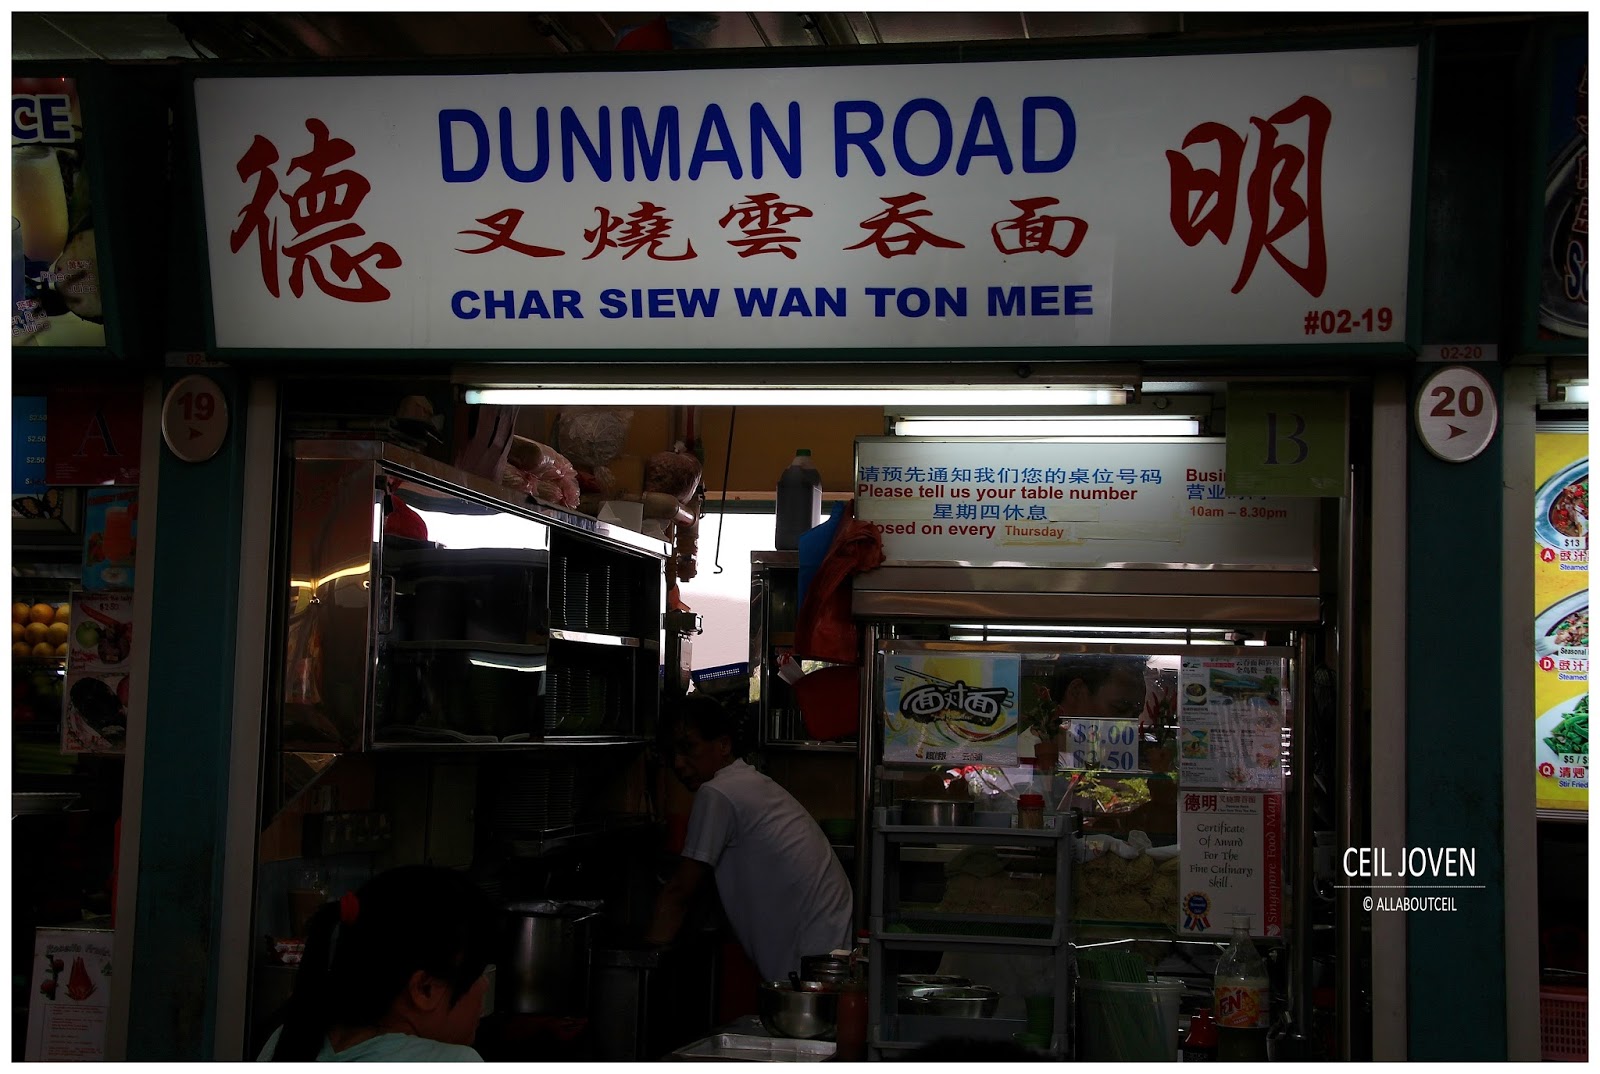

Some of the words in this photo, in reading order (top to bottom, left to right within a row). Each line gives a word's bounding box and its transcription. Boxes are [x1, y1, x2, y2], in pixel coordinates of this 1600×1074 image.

[438, 100, 803, 184] DUNMAN
[834, 95, 1077, 178] ROAD
[1165, 95, 1332, 298] 明
[230, 118, 402, 303] 德
[450, 289, 584, 321] CHAR
[599, 288, 720, 319] SIEW
[734, 287, 848, 319] WAN
[865, 286, 968, 318] TON
[986, 284, 1094, 317] MEE
[1304, 308, 1393, 335] #02-19
[1440, 347, 1482, 359] 02-20
[176, 391, 216, 421] 19
[1429, 386, 1483, 417] 20
[27, 435, 46, 443] $2.50
[1264, 411, 1309, 465] B
[26, 456, 45, 464] $2.50
[859, 466, 1163, 485] 请预先通知我们您的桌位号码
[1186, 468, 1226, 482] Busi
[858, 484, 914, 499] Please
[918, 484, 945, 499] tell
[949, 488, 971, 499] us
[976, 488, 1016, 504] your
[1021, 484, 1064, 499] table
[1069, 484, 1138, 500] number
[932, 503, 1049, 521] 星期四休息
[1190, 507, 1226, 519] 10am
[1239, 507, 1288, 521] 8.30pm
[921, 525, 943, 535] on
[948, 525, 996, 539] every
[1004, 525, 1065, 539] Thursday
[1564, 539, 1580, 547] $13
[1559, 673, 1587, 681] Steamed
[1564, 756, 1573, 764] $5
[1184, 793, 1217, 812] 德明
[1266, 797, 1279, 828] Map
[1197, 820, 1245, 835] Certificate
[1199, 836, 1211, 848] Of
[1214, 838, 1243, 847] Award
[1265, 831, 1276, 860] Food
[1204, 851, 1218, 860] For
[1221, 849, 1239, 861] The
[1190, 864, 1208, 873] Fine
[1211, 863, 1253, 877] Culinary
[1208, 875, 1228, 888] Skill
[1265, 864, 1280, 923] Singapore
